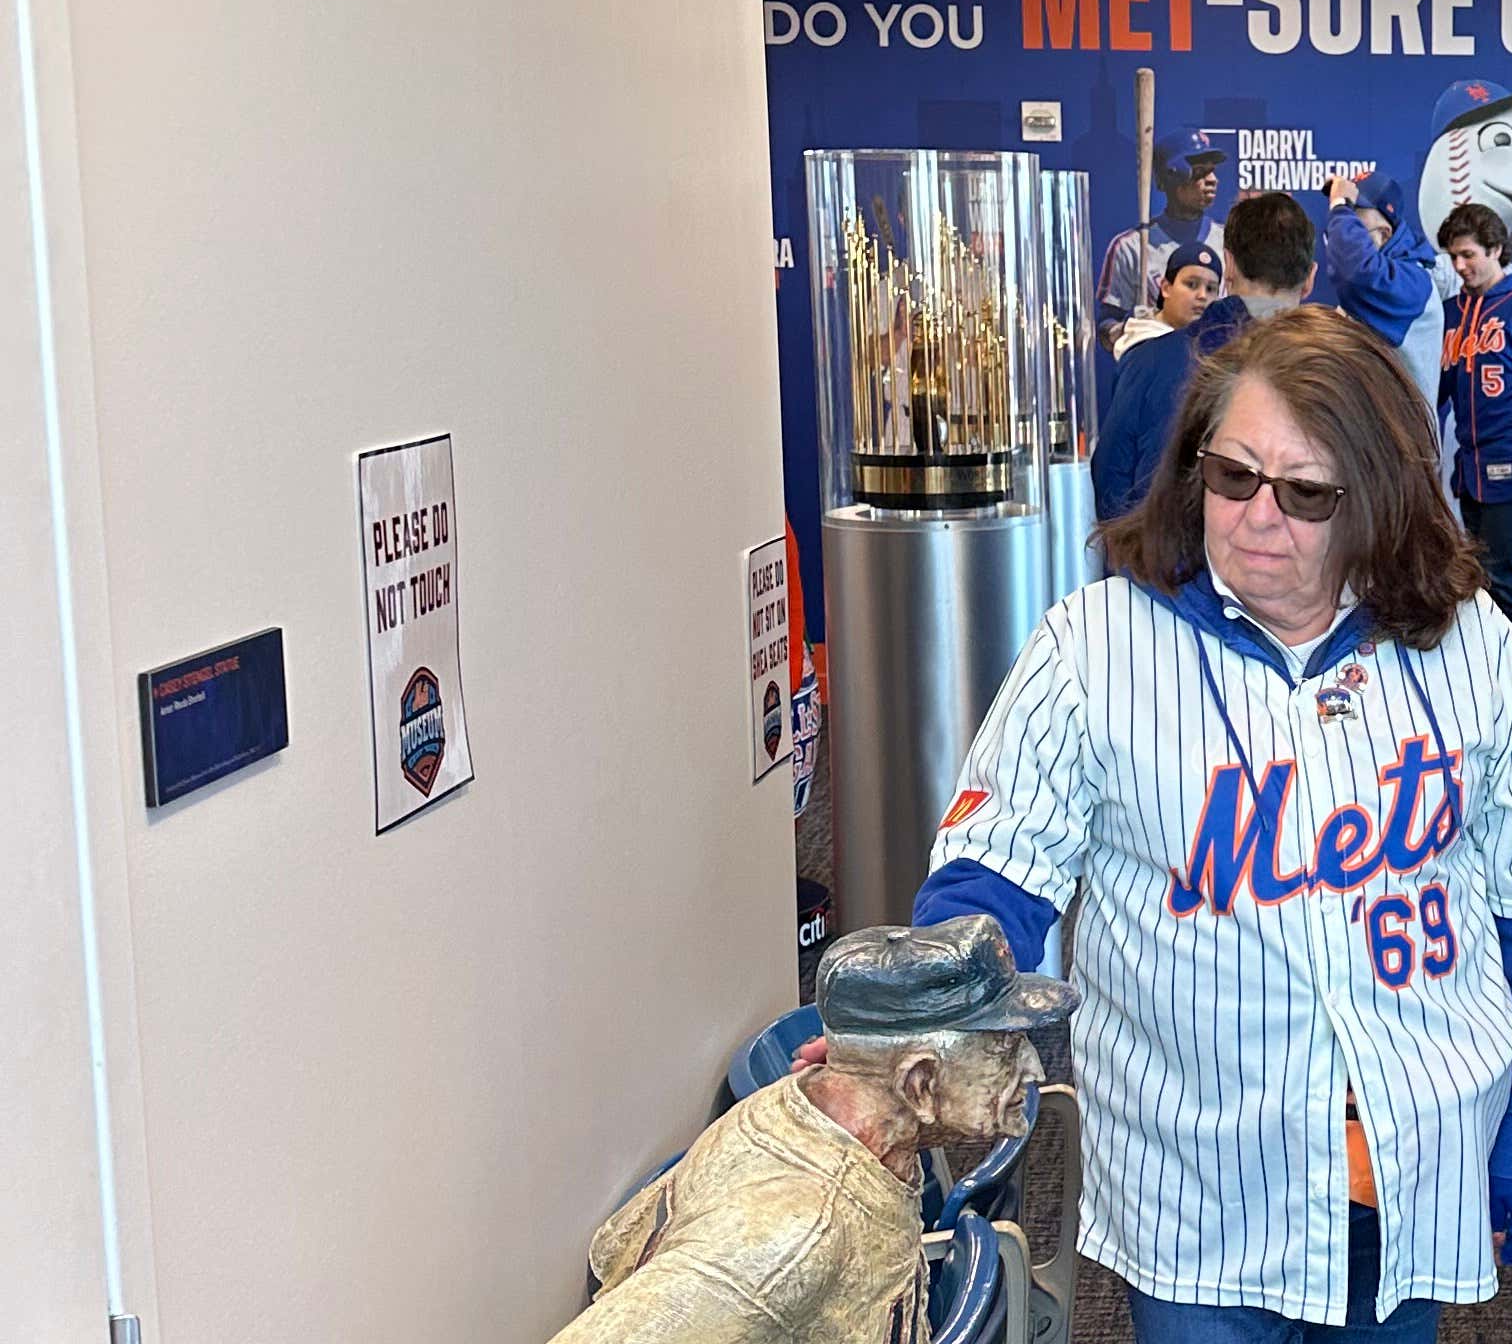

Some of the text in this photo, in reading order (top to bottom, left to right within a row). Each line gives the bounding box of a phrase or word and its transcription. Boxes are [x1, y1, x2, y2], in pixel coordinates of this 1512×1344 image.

[764, 1, 847, 47] DO
[863, 3, 984, 50] YOU
[1238, 129, 1317, 160] DARRYL
[1441, 317, 1505, 371] Mets
[1480, 364, 1505, 397] 5
[373, 502, 449, 567] PLEASE DO
[375, 562, 451, 634] NOT TOUCH
[752, 559, 784, 600] PLEASE DO
[752, 597, 786, 641] NOT SIT ON
[401, 705, 444, 759] MUSEUM
[1168, 734, 1464, 919] Mets
[799, 912, 826, 947] citi
[1351, 883, 1460, 991] '69
